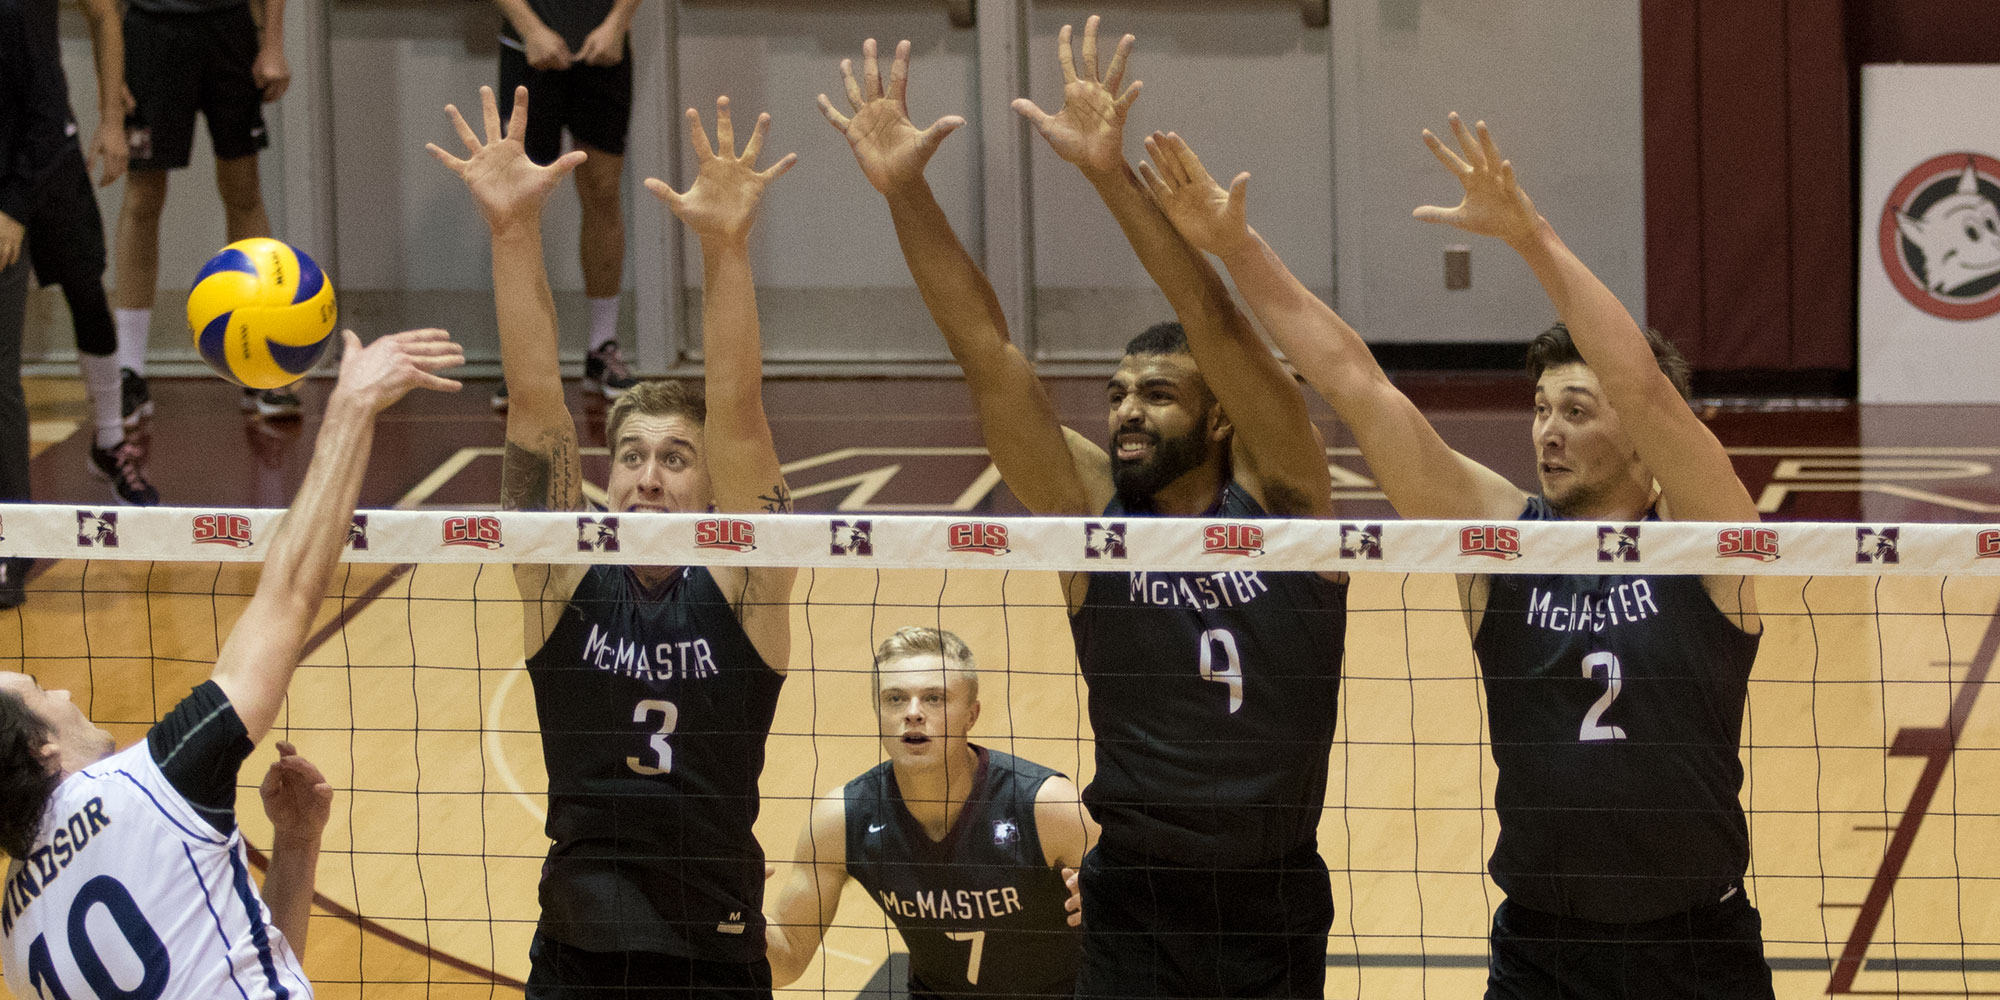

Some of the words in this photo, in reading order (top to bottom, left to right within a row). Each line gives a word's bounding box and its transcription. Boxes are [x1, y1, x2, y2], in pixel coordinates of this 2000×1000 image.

[193, 513, 252, 543] SIC
[442, 515, 503, 546] CIS
[695, 517, 756, 547] SIC
[947, 521, 1009, 551] CIS
[1203, 523, 1265, 552] SIC
[1458, 525, 1522, 554] CIS
[1717, 527, 1780, 556] SIC
[1200, 628, 1244, 714] 9
[1579, 651, 1628, 742] 2
[626, 699, 679, 776] 3
[28, 874, 171, 1000] 10
[944, 930, 986, 986] 7
